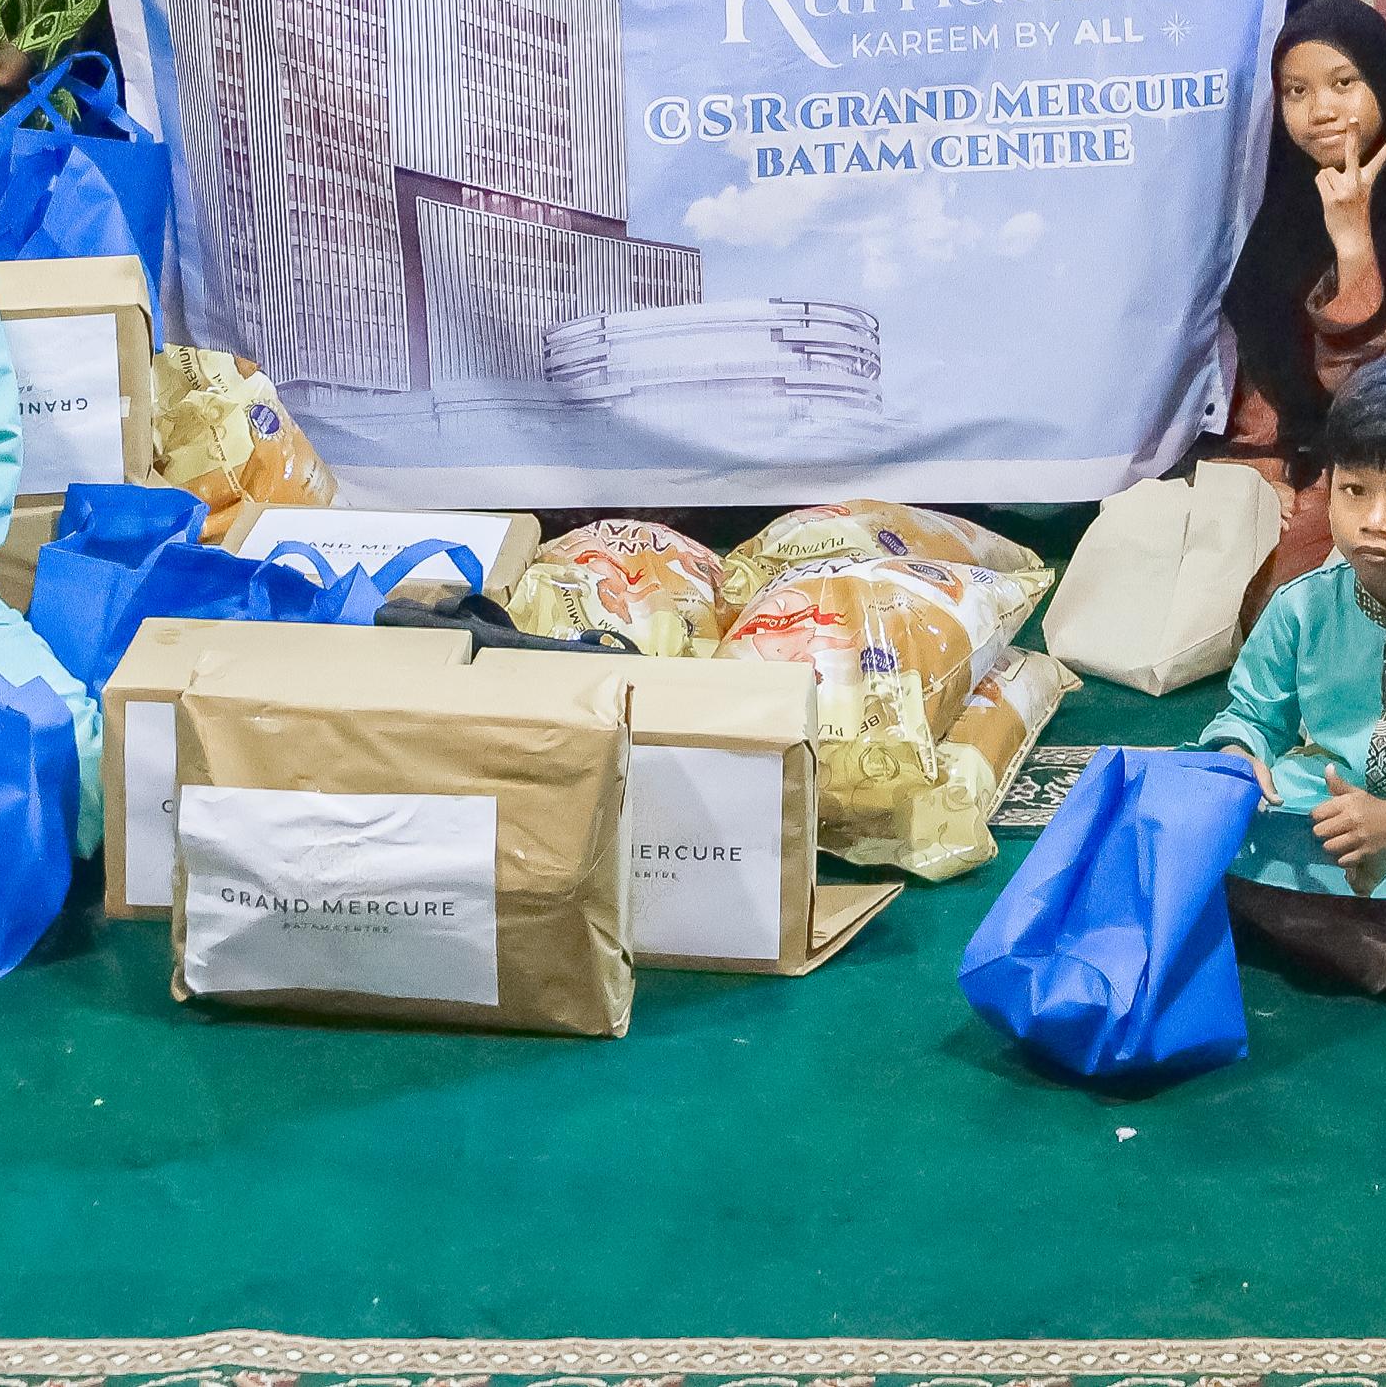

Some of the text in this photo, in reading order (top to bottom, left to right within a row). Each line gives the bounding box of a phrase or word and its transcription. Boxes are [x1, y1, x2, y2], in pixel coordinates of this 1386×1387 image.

[851, 16, 1145, 59] KAREEM BY ALL
[799, 88, 978, 131] GRAND
[991, 72, 1226, 119] MERCURE
[756, 128, 1131, 178] BATAM CENTRE
[777, 537, 845, 556] PLATINUM
[220, 887, 455, 916] GRAND MERCURE
